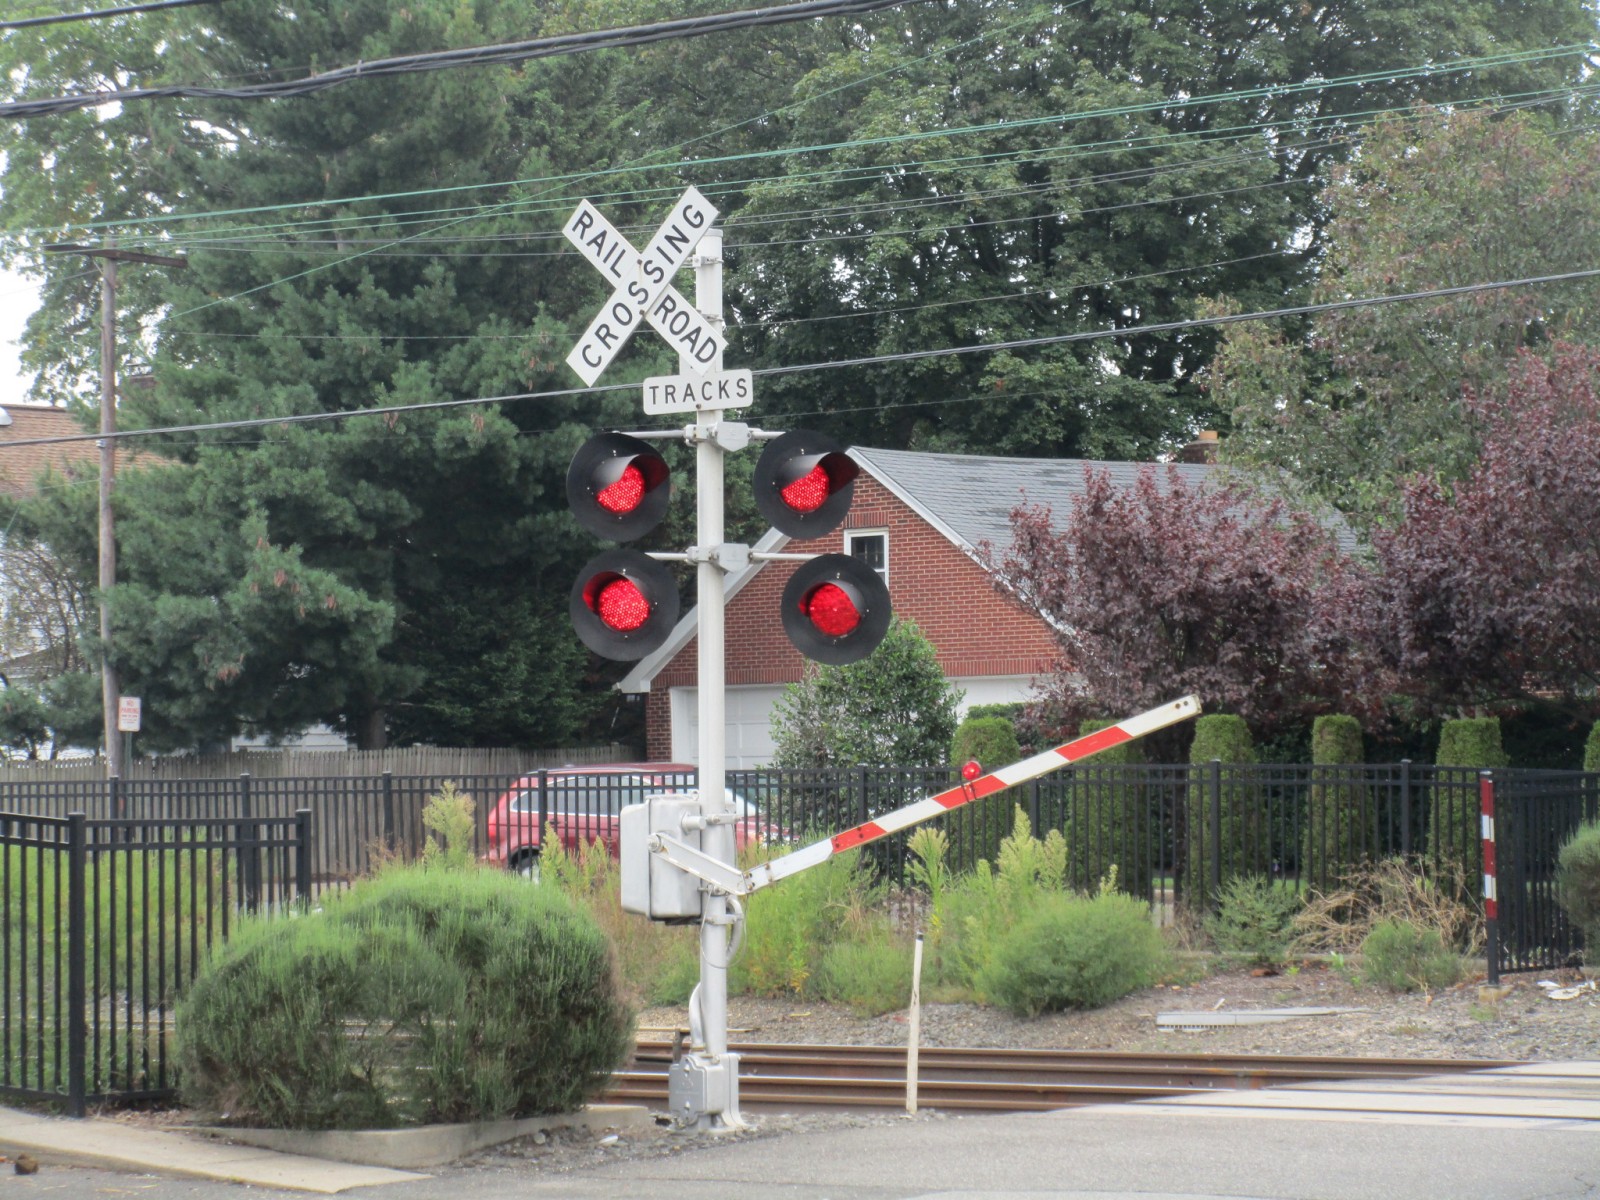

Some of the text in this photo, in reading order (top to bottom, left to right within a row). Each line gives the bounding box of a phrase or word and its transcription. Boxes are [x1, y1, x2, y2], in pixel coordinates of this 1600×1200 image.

[572, 210, 718, 364] RAIL ROAD
[581, 204, 705, 368] CROSSING
[649, 379, 748, 405] TRACKS
